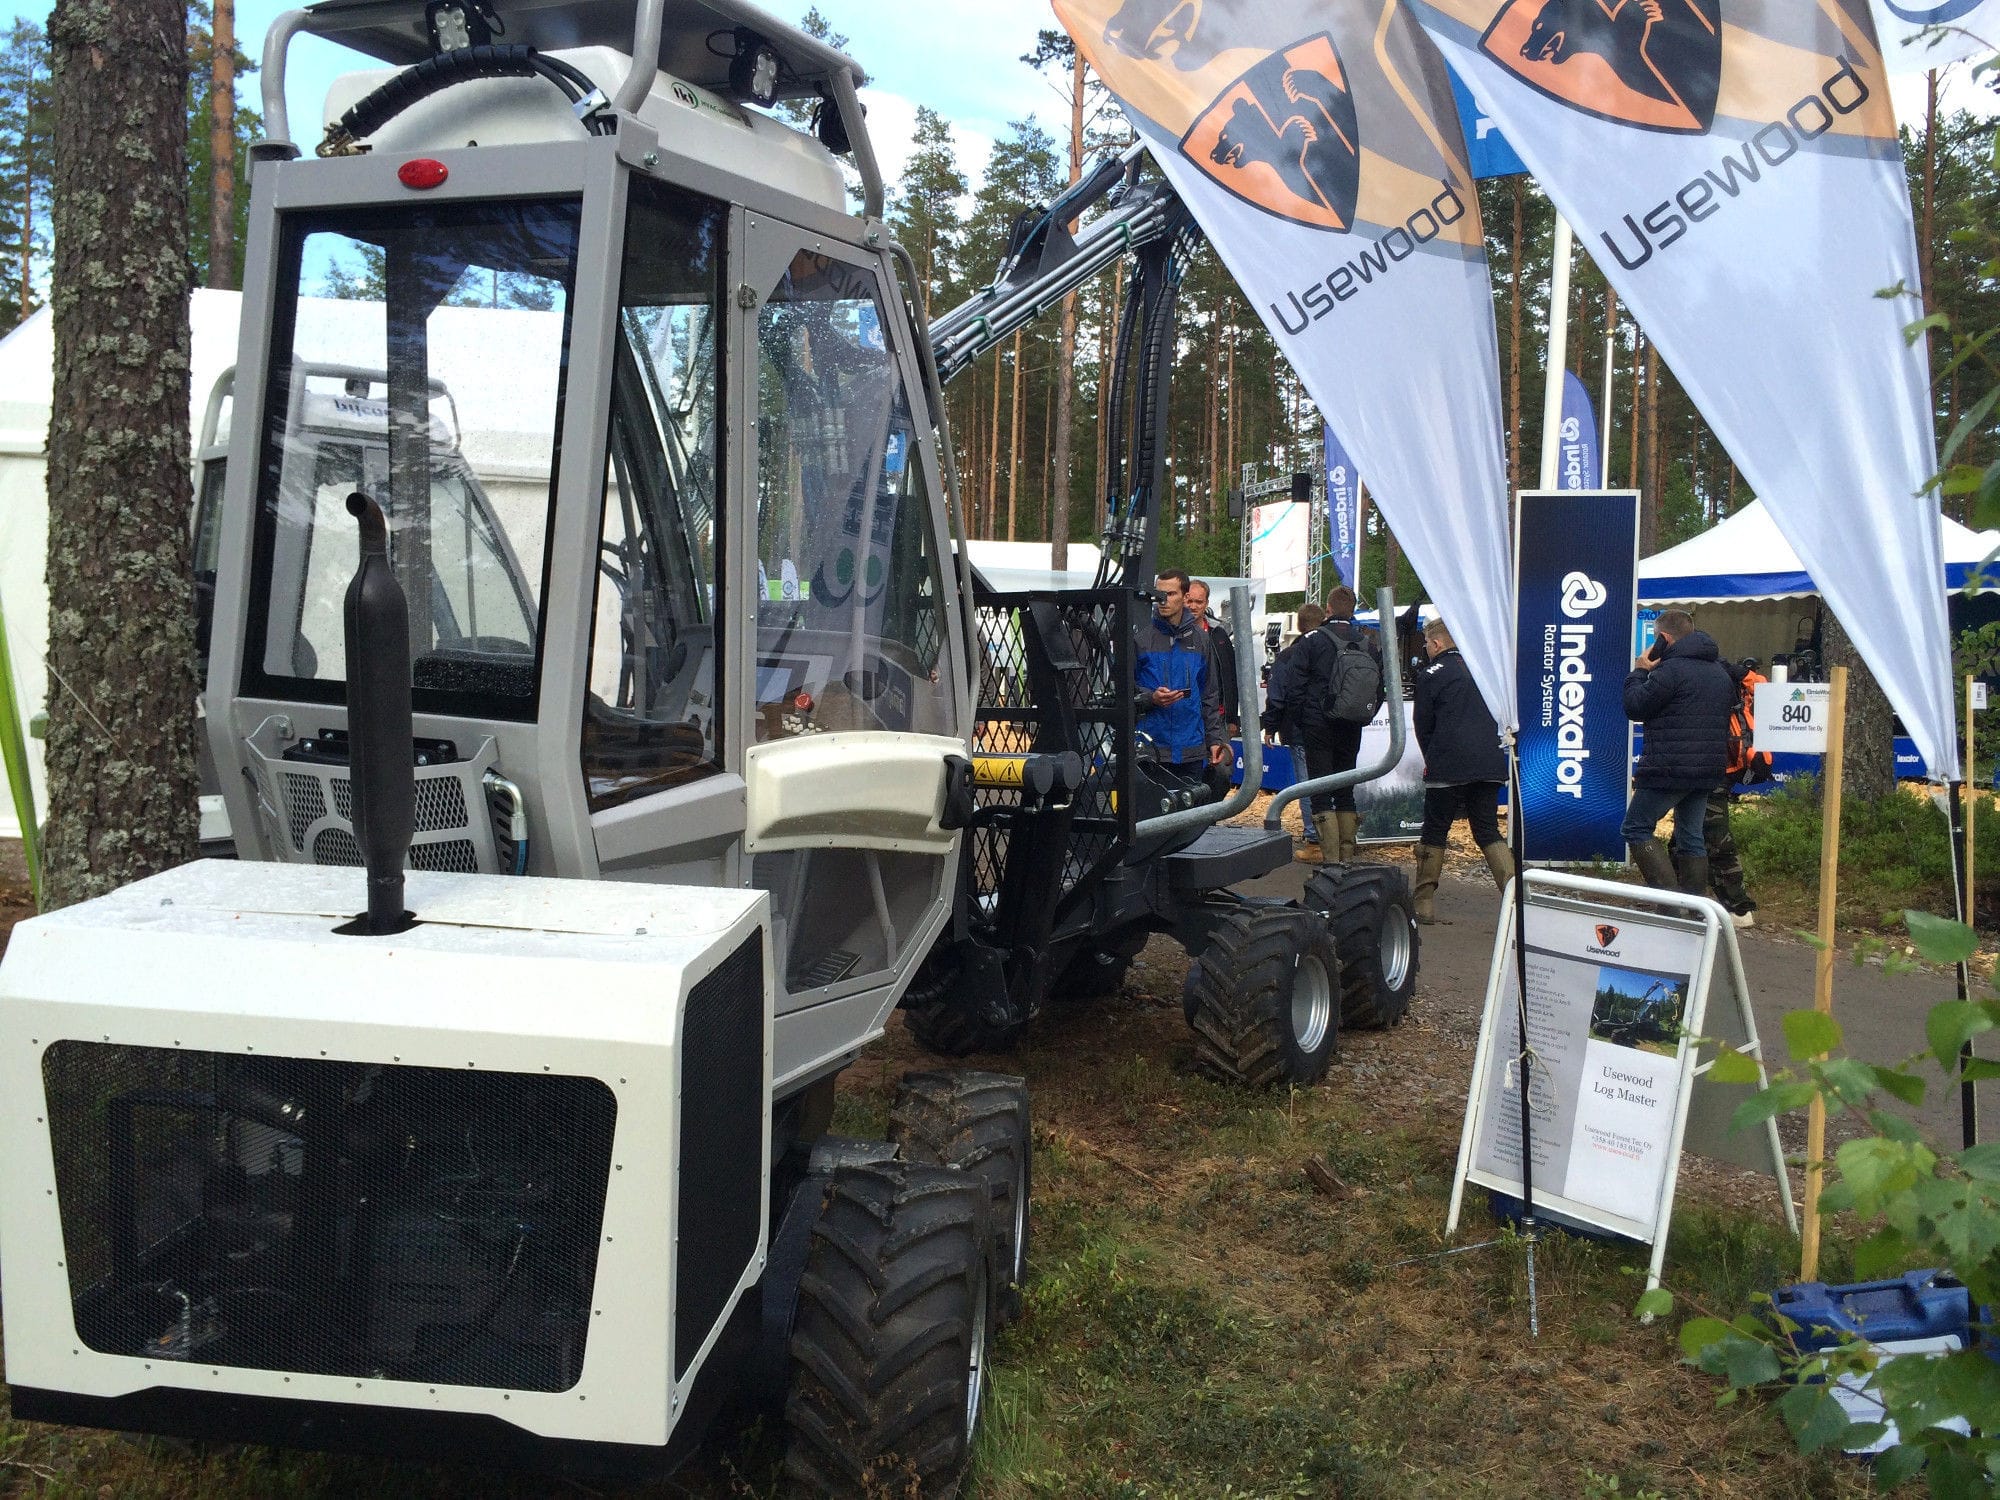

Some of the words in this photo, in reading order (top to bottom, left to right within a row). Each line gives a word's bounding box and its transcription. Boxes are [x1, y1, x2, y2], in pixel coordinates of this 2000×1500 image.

[1599, 55, 1870, 271] Usewood
[1271, 180, 1466, 336] Usewood
[1543, 624, 1557, 670] Rotator
[1541, 674, 1555, 727] Systems
[1556, 624, 1594, 798] Indexator
[1781, 704, 1811, 723] 840
[1586, 945, 1620, 958] Usewood
[1594, 1081, 1615, 1099] Log
[1617, 1088, 1657, 1108] Master
[1602, 1065, 1653, 1088] Usewood
